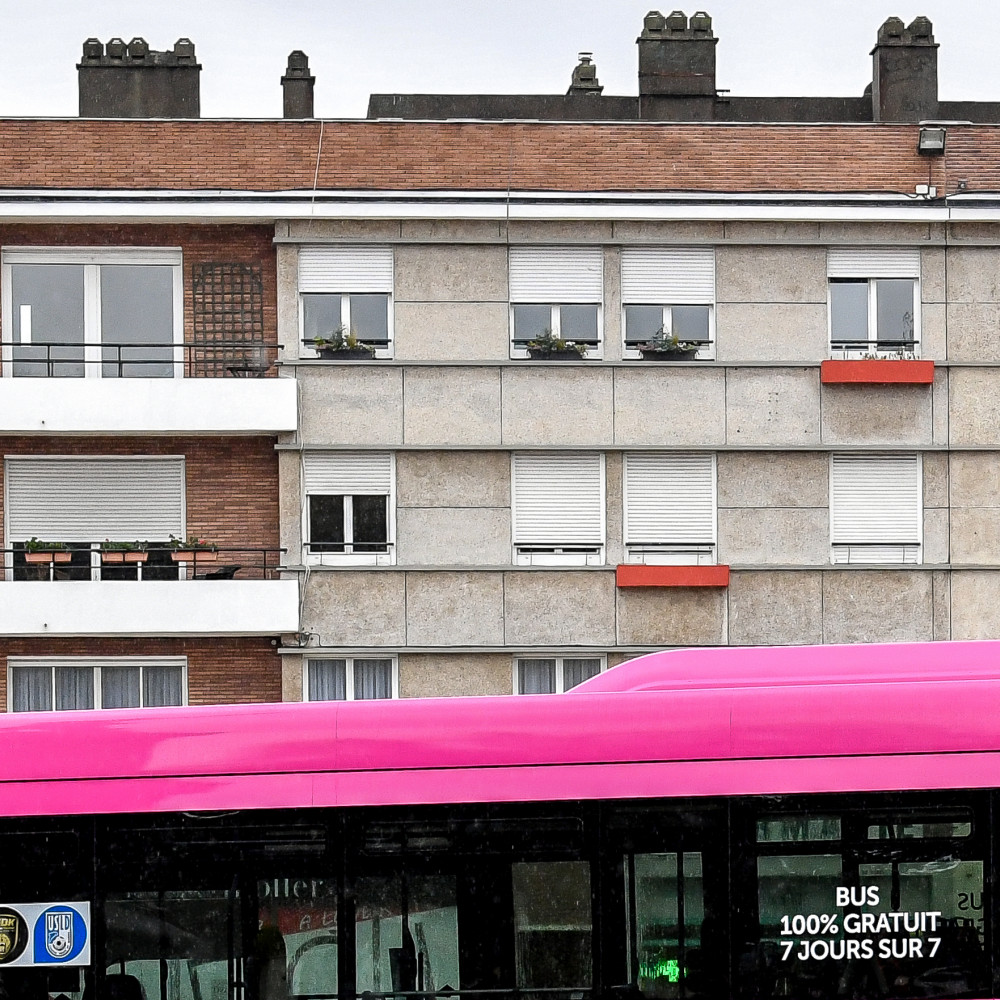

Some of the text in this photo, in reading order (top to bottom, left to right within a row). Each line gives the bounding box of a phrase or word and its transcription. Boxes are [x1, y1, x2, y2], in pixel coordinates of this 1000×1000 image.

[837, 886, 879, 906] BUS
[781, 914, 838, 935] 100%
[844, 912, 941, 933] GRATUIT
[781, 938, 941, 960] 7 JOURS SUR 7
